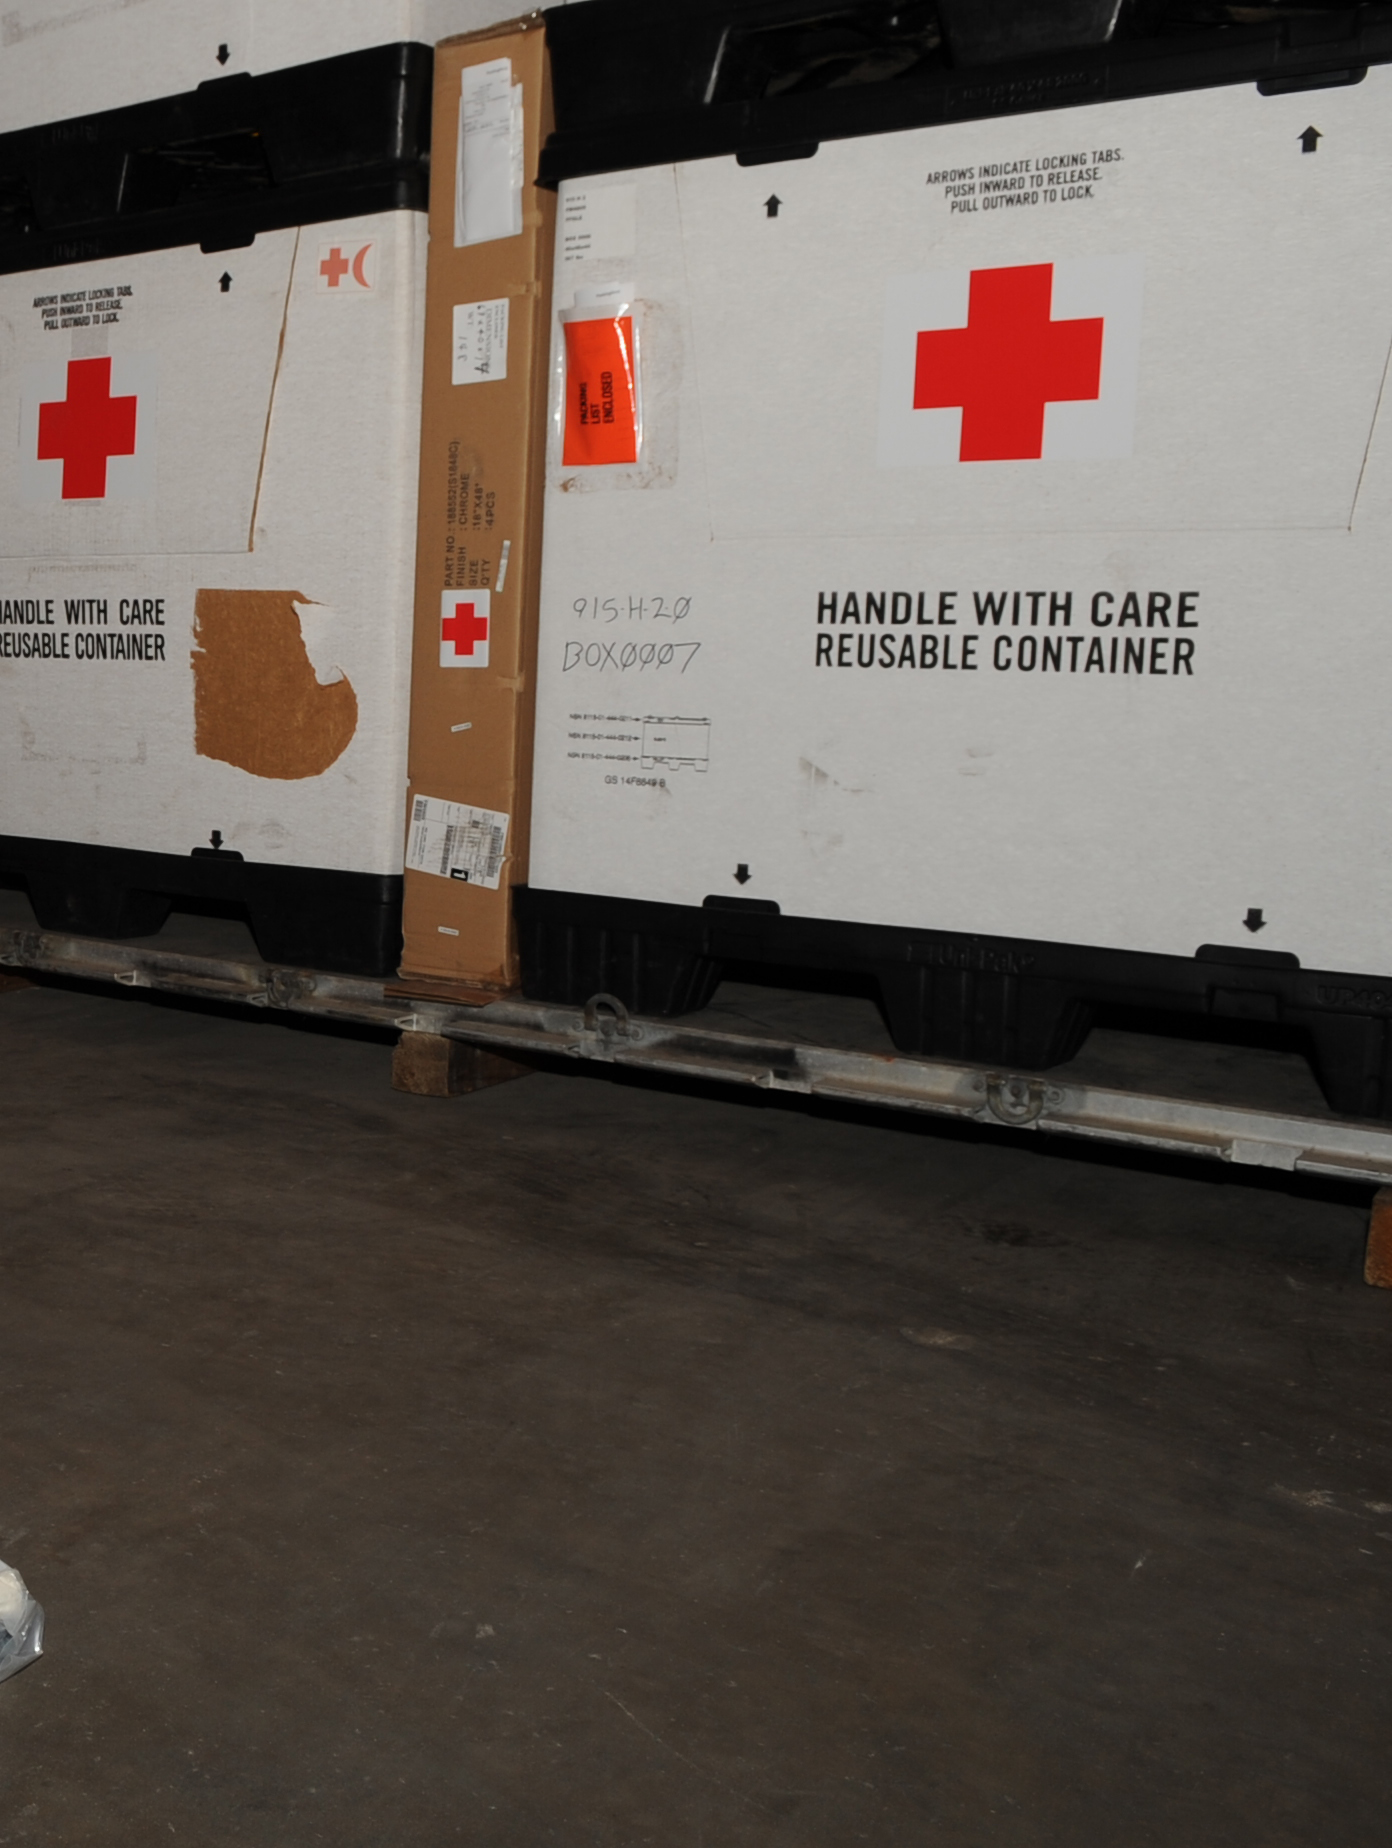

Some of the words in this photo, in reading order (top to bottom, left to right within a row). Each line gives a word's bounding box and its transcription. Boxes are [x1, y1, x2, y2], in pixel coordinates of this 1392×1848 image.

[925, 166, 975, 185] ARROWS
[978, 159, 1032, 178] INDICATE
[1035, 152, 1087, 171] LOCKING
[1091, 148, 1124, 164] TABS.
[944, 182, 975, 199] PUSH
[979, 176, 1026, 194] INWARD
[1029, 173, 1044, 189] TO
[1047, 166, 1103, 186] RELEASE.
[950, 198, 979, 214] PULL
[982, 191, 1039, 211] OUTWARD
[1042, 189, 1057, 203] TO
[1061, 184, 1095, 201] LOCK.
[33, 295, 59, 308] ARROWS
[60, 290, 87, 304] INDICATE
[88, 287, 115, 301] LOCKING
[41, 308, 58, 319] PUSH
[60, 304, 84, 316] INWARD
[86, 302, 94, 313] TO
[44, 319, 59, 330] PULL
[61, 315, 91, 329] OUTWARD
[92, 314, 101, 325] TO
[579, 382, 589, 425] PACKING
[601, 371, 615, 424] ENCLOSED
[590, 403, 601, 424] LIST
[444, 559, 454, 587] PART
[456, 546, 466, 587] FINISH
[469, 560, 479, 586] SIZE
[64, 599, 108, 625] WITH
[119, 599, 166, 626] CARE
[816, 591, 958, 625] HANDLE
[973, 591, 1073, 626] WITH
[1091, 591, 1200, 628] CARE
[75, 632, 166, 662] CONTAINER
[815, 633, 979, 670] REUSABLE
[993, 635, 1196, 676] CONTAINER
